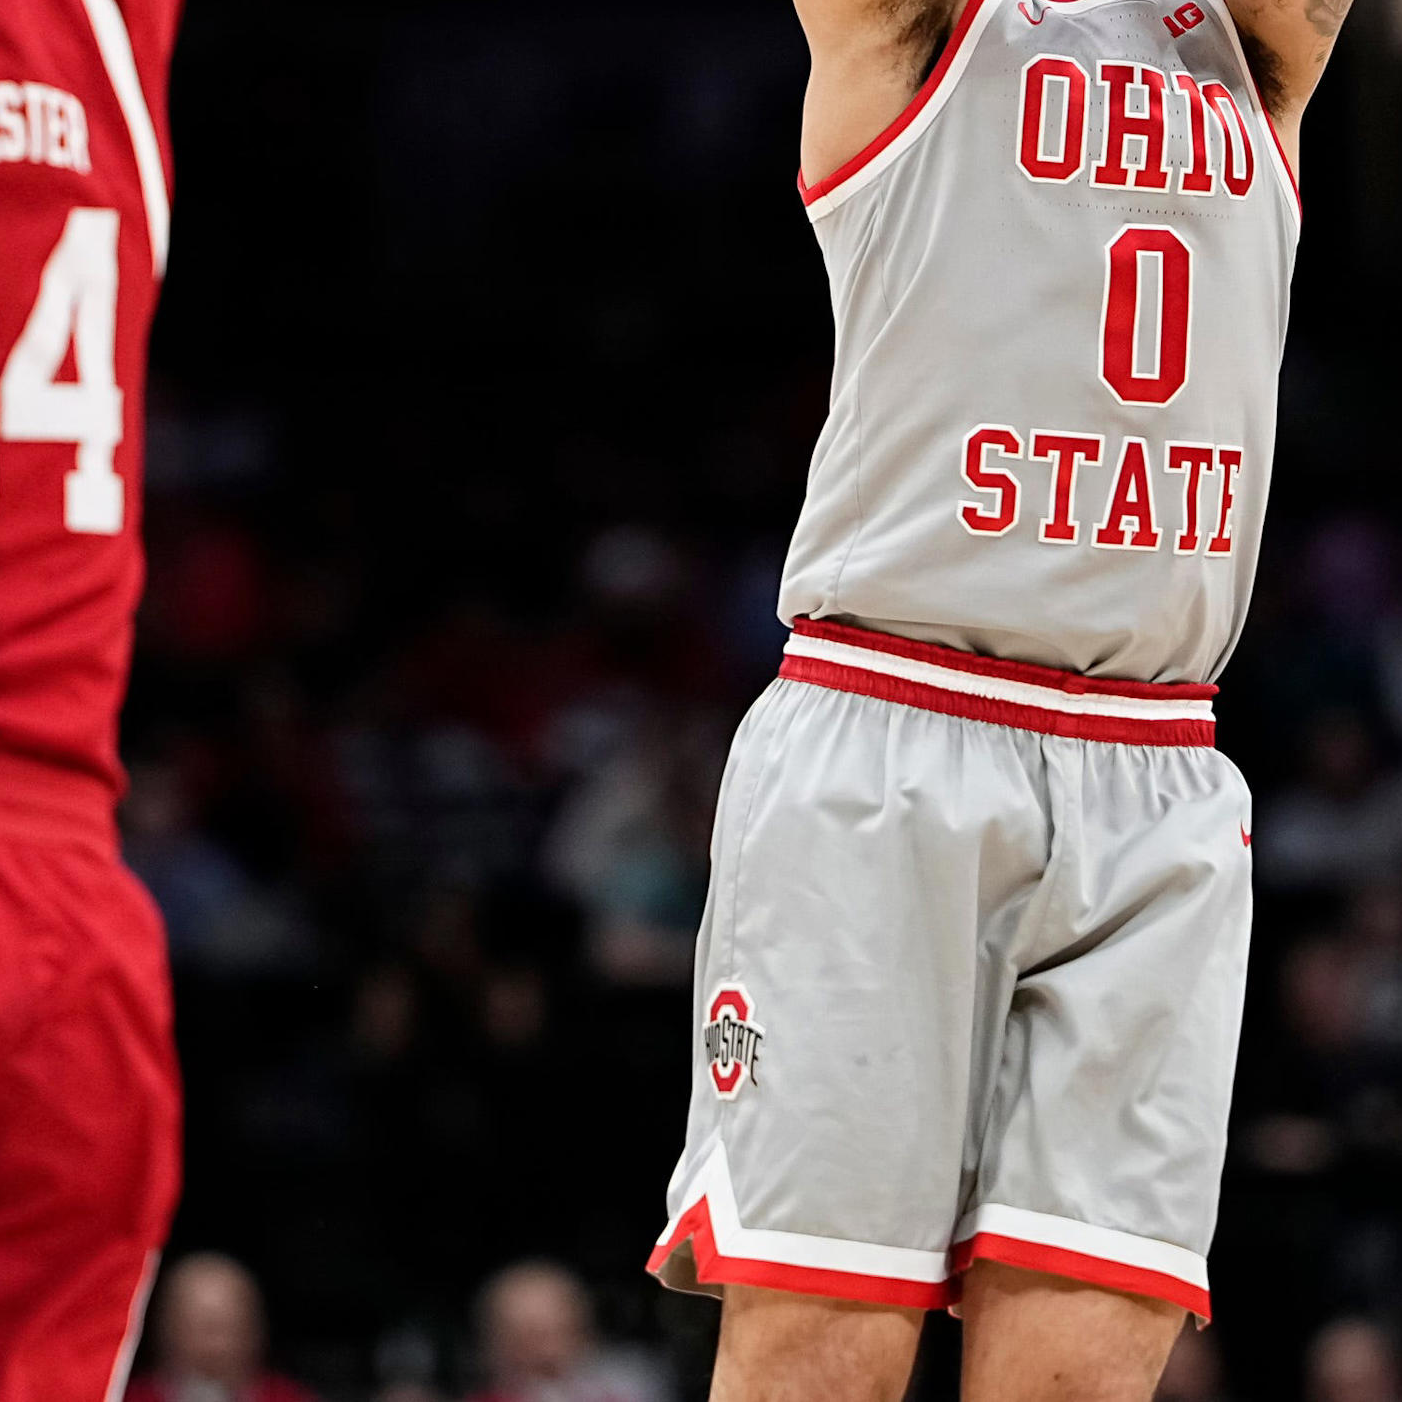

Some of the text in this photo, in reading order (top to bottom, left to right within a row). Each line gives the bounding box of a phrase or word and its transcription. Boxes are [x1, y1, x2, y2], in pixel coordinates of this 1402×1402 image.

[1014, 53, 1256, 201] OHIO
[1097, 222, 1192, 409] 0
[957, 422, 1245, 559] STATE
